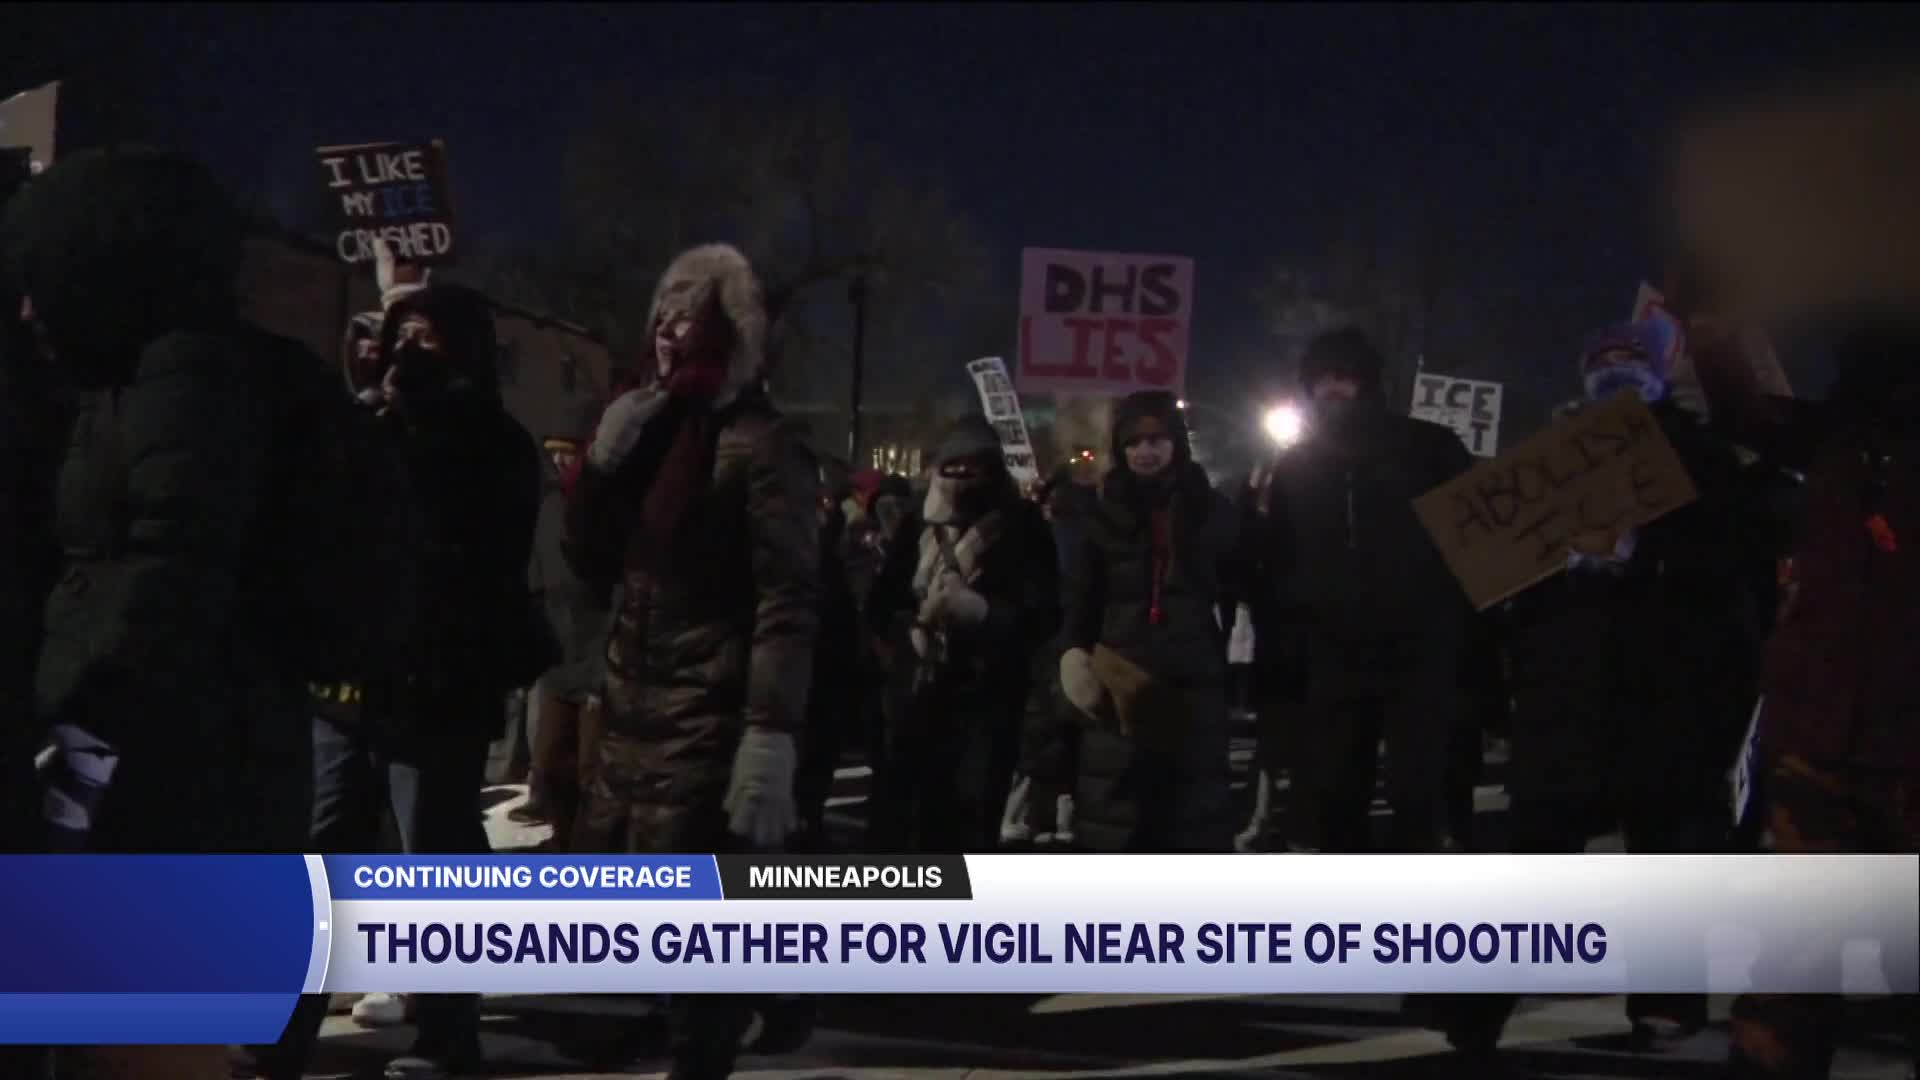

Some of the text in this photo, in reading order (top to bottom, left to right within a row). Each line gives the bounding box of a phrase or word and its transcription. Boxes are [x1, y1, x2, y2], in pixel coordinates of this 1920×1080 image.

[320, 151, 425, 187] I LIKE
[341, 184, 432, 217] MY ICE
[1045, 264, 1181, 316] DHS
[1021, 318, 1179, 387] LIES
[1417, 379, 1497, 420] ICE
[1452, 412, 1652, 548] ABOLISH
[1515, 452, 1660, 563] ICE
